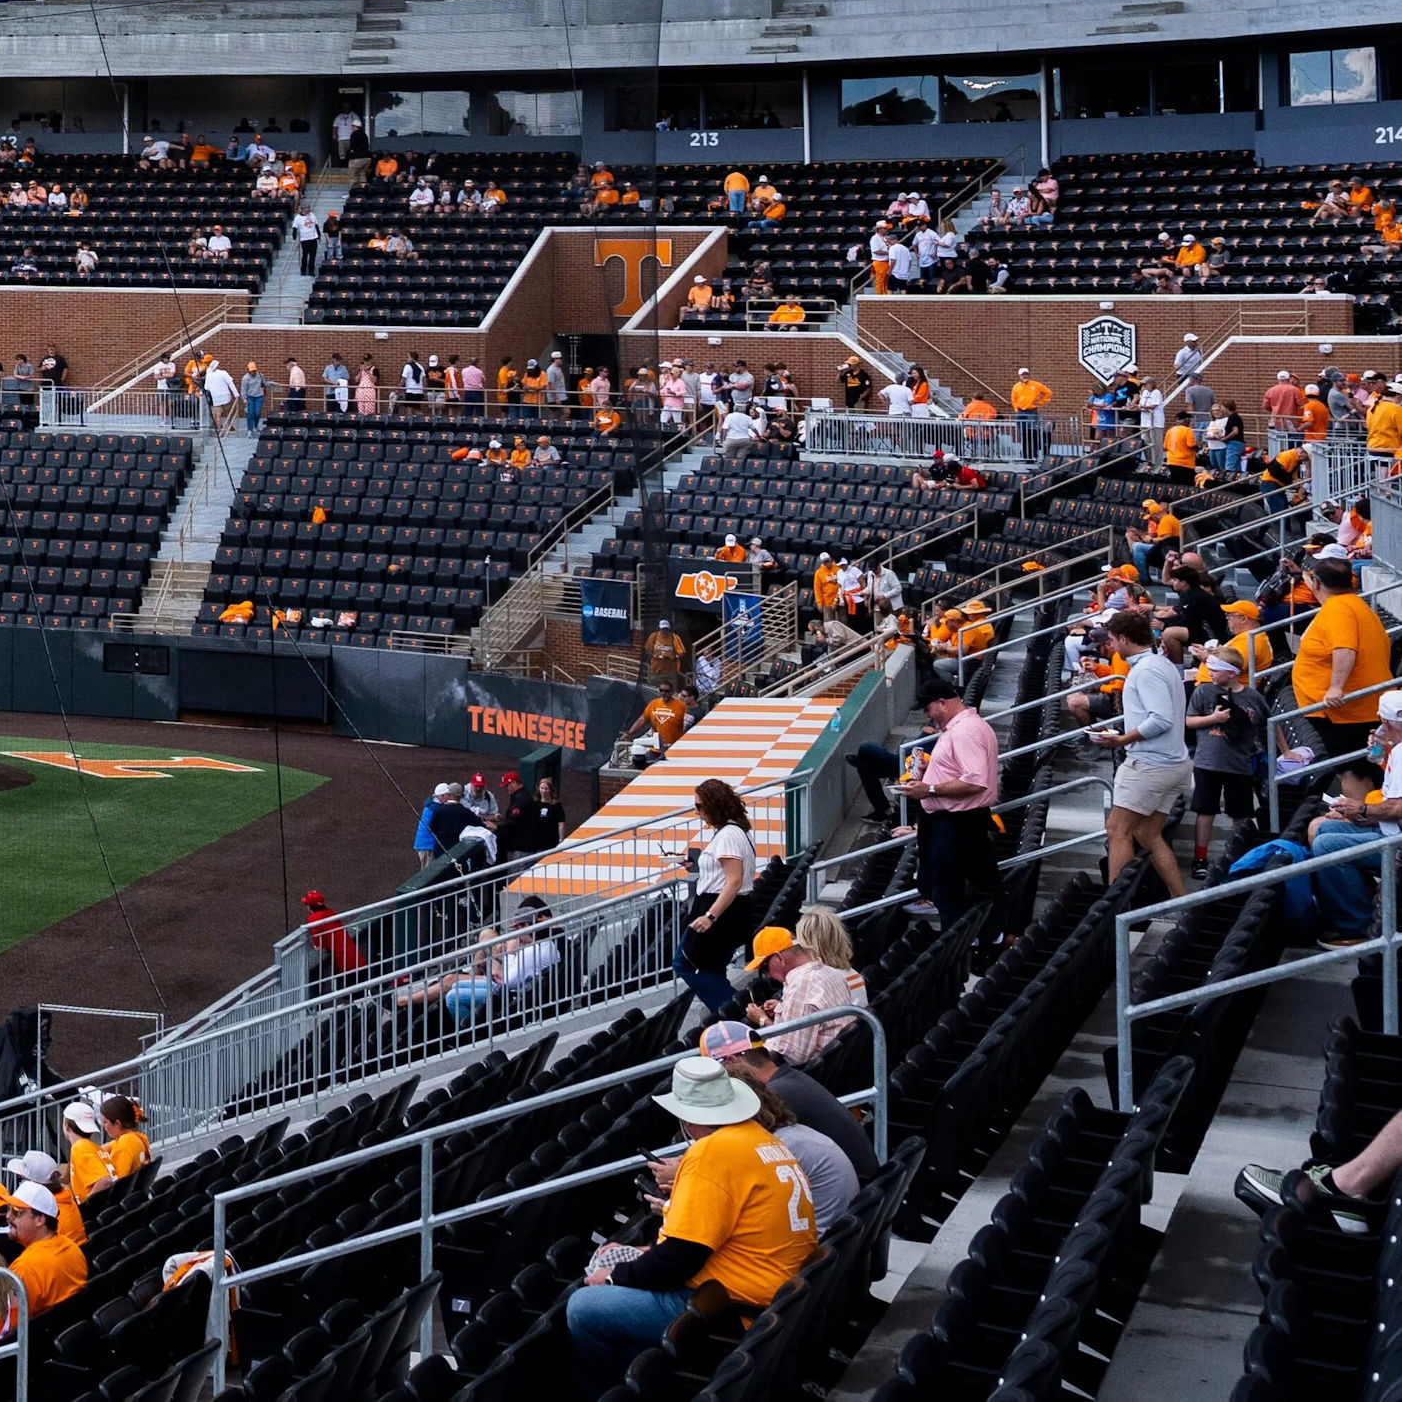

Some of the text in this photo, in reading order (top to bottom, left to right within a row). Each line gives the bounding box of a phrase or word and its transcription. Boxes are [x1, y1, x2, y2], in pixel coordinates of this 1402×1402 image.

[689, 132, 719, 147] 213
[1090, 335, 1123, 345] NATIONAL
[1083, 343, 1131, 356] CHAMPIONS
[594, 606, 628, 619] BASEBALL
[467, 705, 587, 751] TENNESSEE
[457, 1299, 466, 1311] 7
